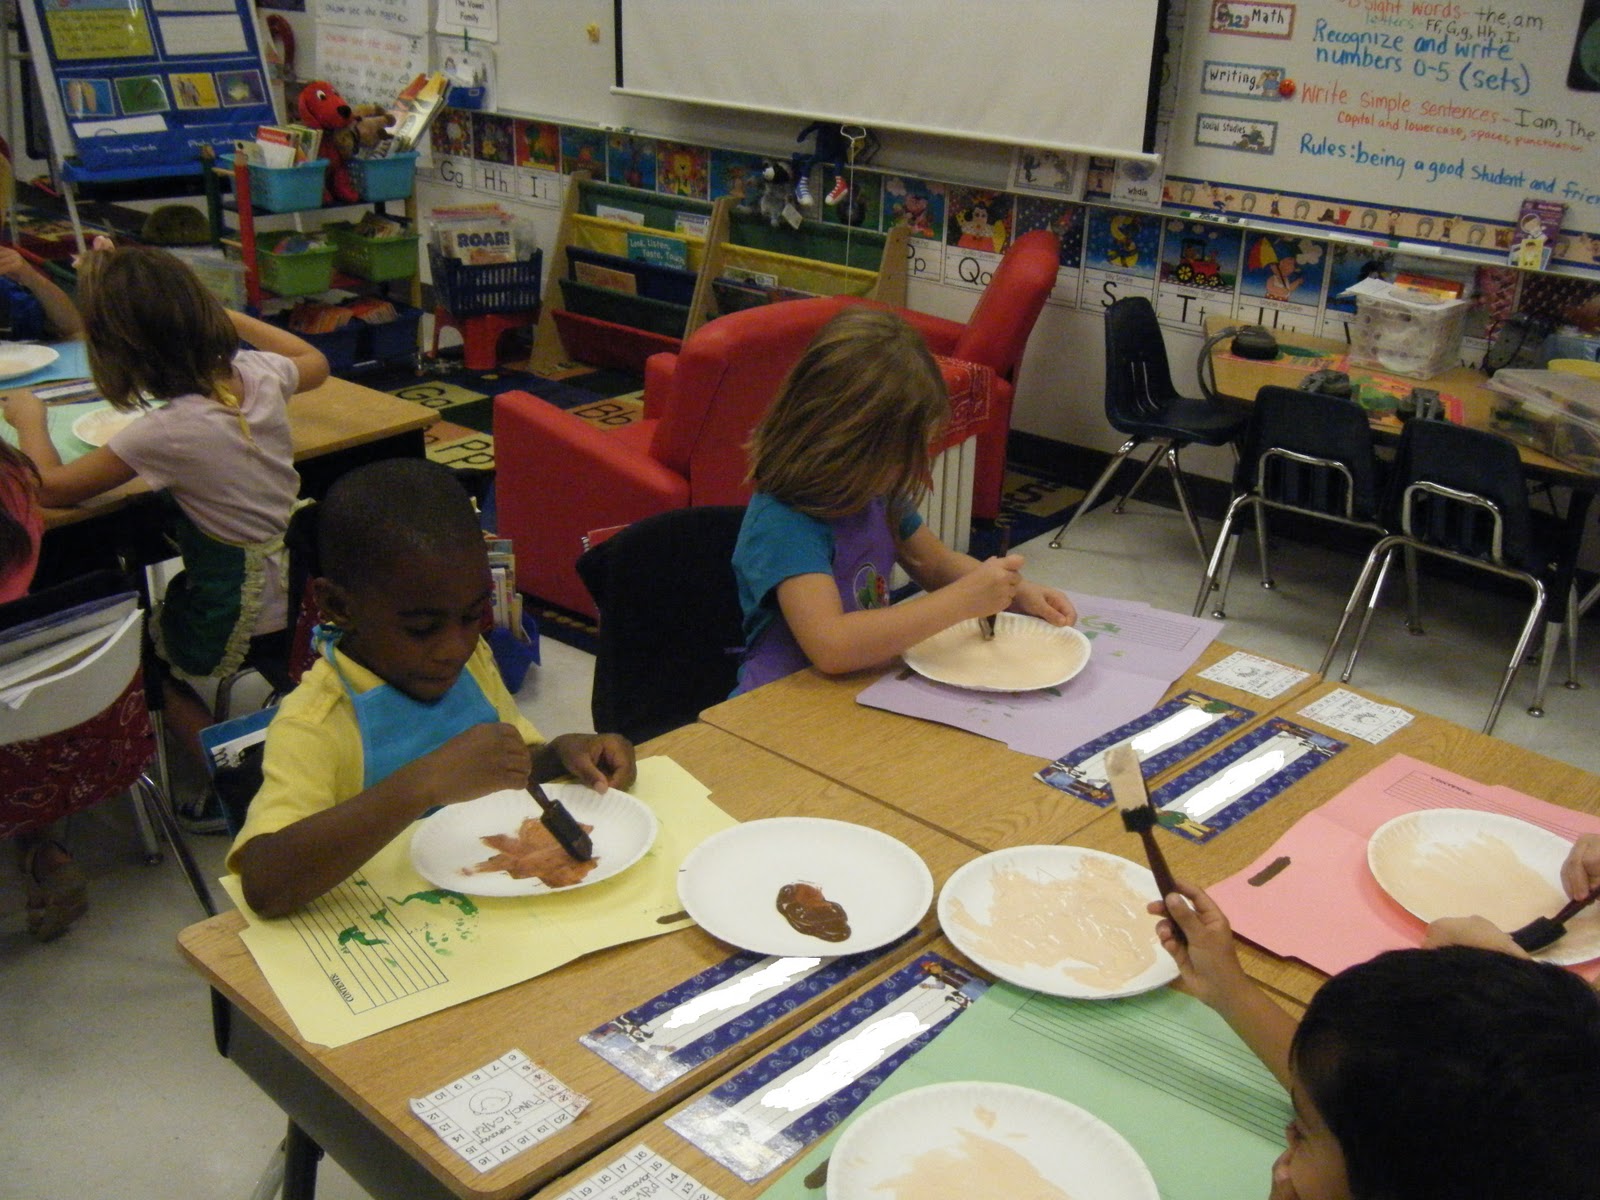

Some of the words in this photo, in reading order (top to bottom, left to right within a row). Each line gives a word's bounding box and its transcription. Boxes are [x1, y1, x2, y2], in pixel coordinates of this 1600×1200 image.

[1252, 8, 1285, 25] Math
[1313, 17, 1404, 51] Recognize
[1414, 34, 1449, 55] and
[1455, 38, 1514, 60] write
[1316, 47, 1402, 73] numbers
[1414, 59, 1450, 82] 0-5
[1209, 69, 1257, 91] Writing
[1202, 120, 1220, 132] Social
[1222, 122, 1246, 134] Studies
[441, 160, 463, 189] Gg
[484, 168, 508, 192] Hh
[1428, 158, 1465, 182] good
[1529, 177, 1557, 194] and
[1127, 187, 1148, 196] whale
[427, 1111, 441, 1120] 12
[553, 1113, 569, 1124] 20
[438, 1122, 452, 1132] 13
[536, 1124, 550, 1134] 19
[451, 1133, 465, 1143] 14
[500, 1144, 511, 1155] 17
[635, 1150, 648, 1161] 16
[616, 1163, 628, 1174] 17
[649, 1161, 663, 1172] 15
[598, 1174, 612, 1185] 18
[665, 1172, 680, 1184] 14
[619, 1172, 651, 1196] behavior
[681, 1182, 694, 1194] 13
[579, 1187, 593, 1197] 19
